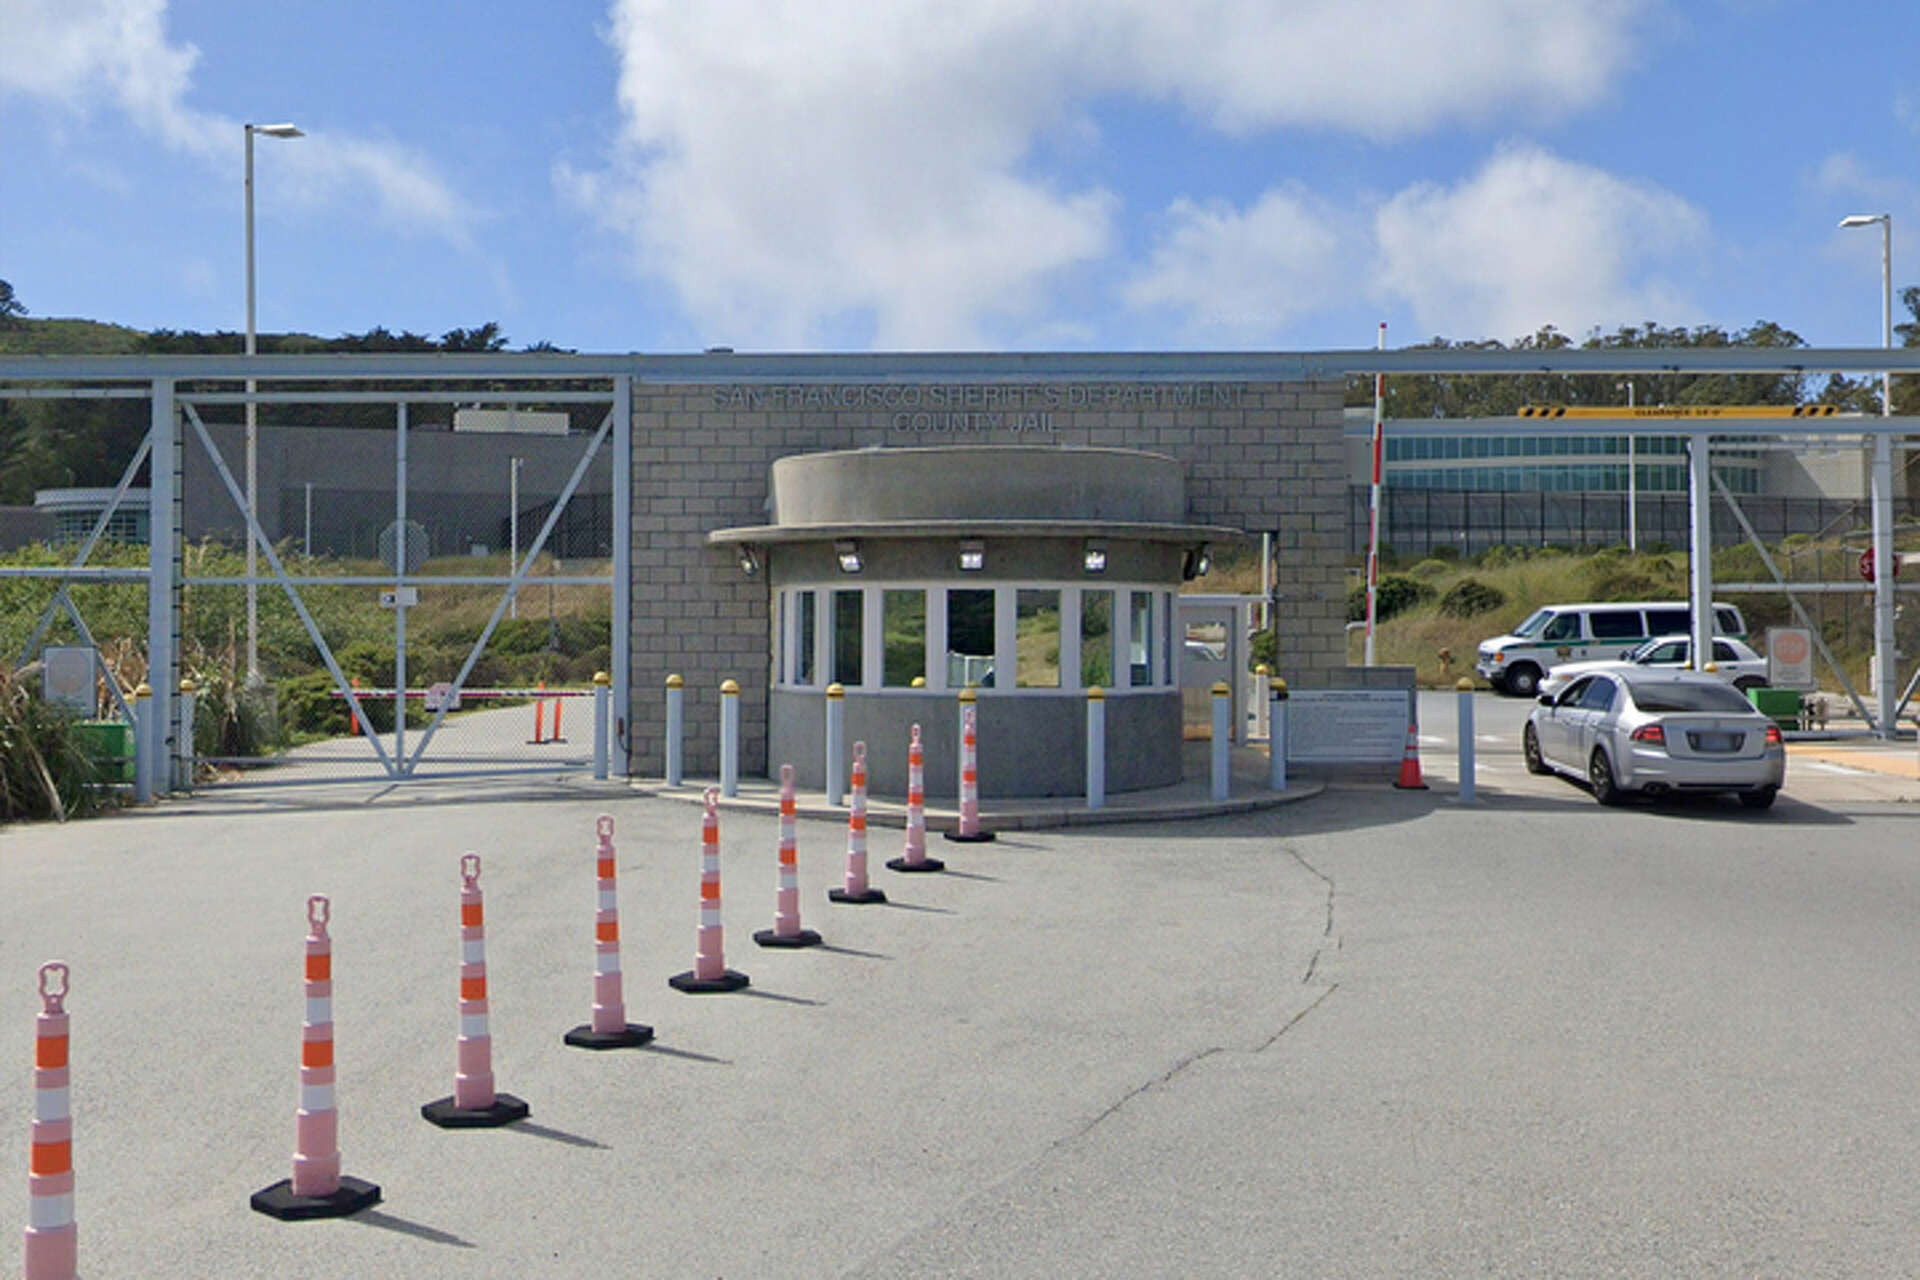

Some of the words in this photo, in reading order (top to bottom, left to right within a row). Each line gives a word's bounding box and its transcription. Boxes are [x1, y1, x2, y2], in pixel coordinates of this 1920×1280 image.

[712, 385, 765, 406] SAN
[772, 385, 921, 406] FRANCISCO
[1069, 384, 1246, 406] DEPARTMENT
[892, 412, 1002, 433] COUNTY
[1009, 412, 1060, 433] JAIL
